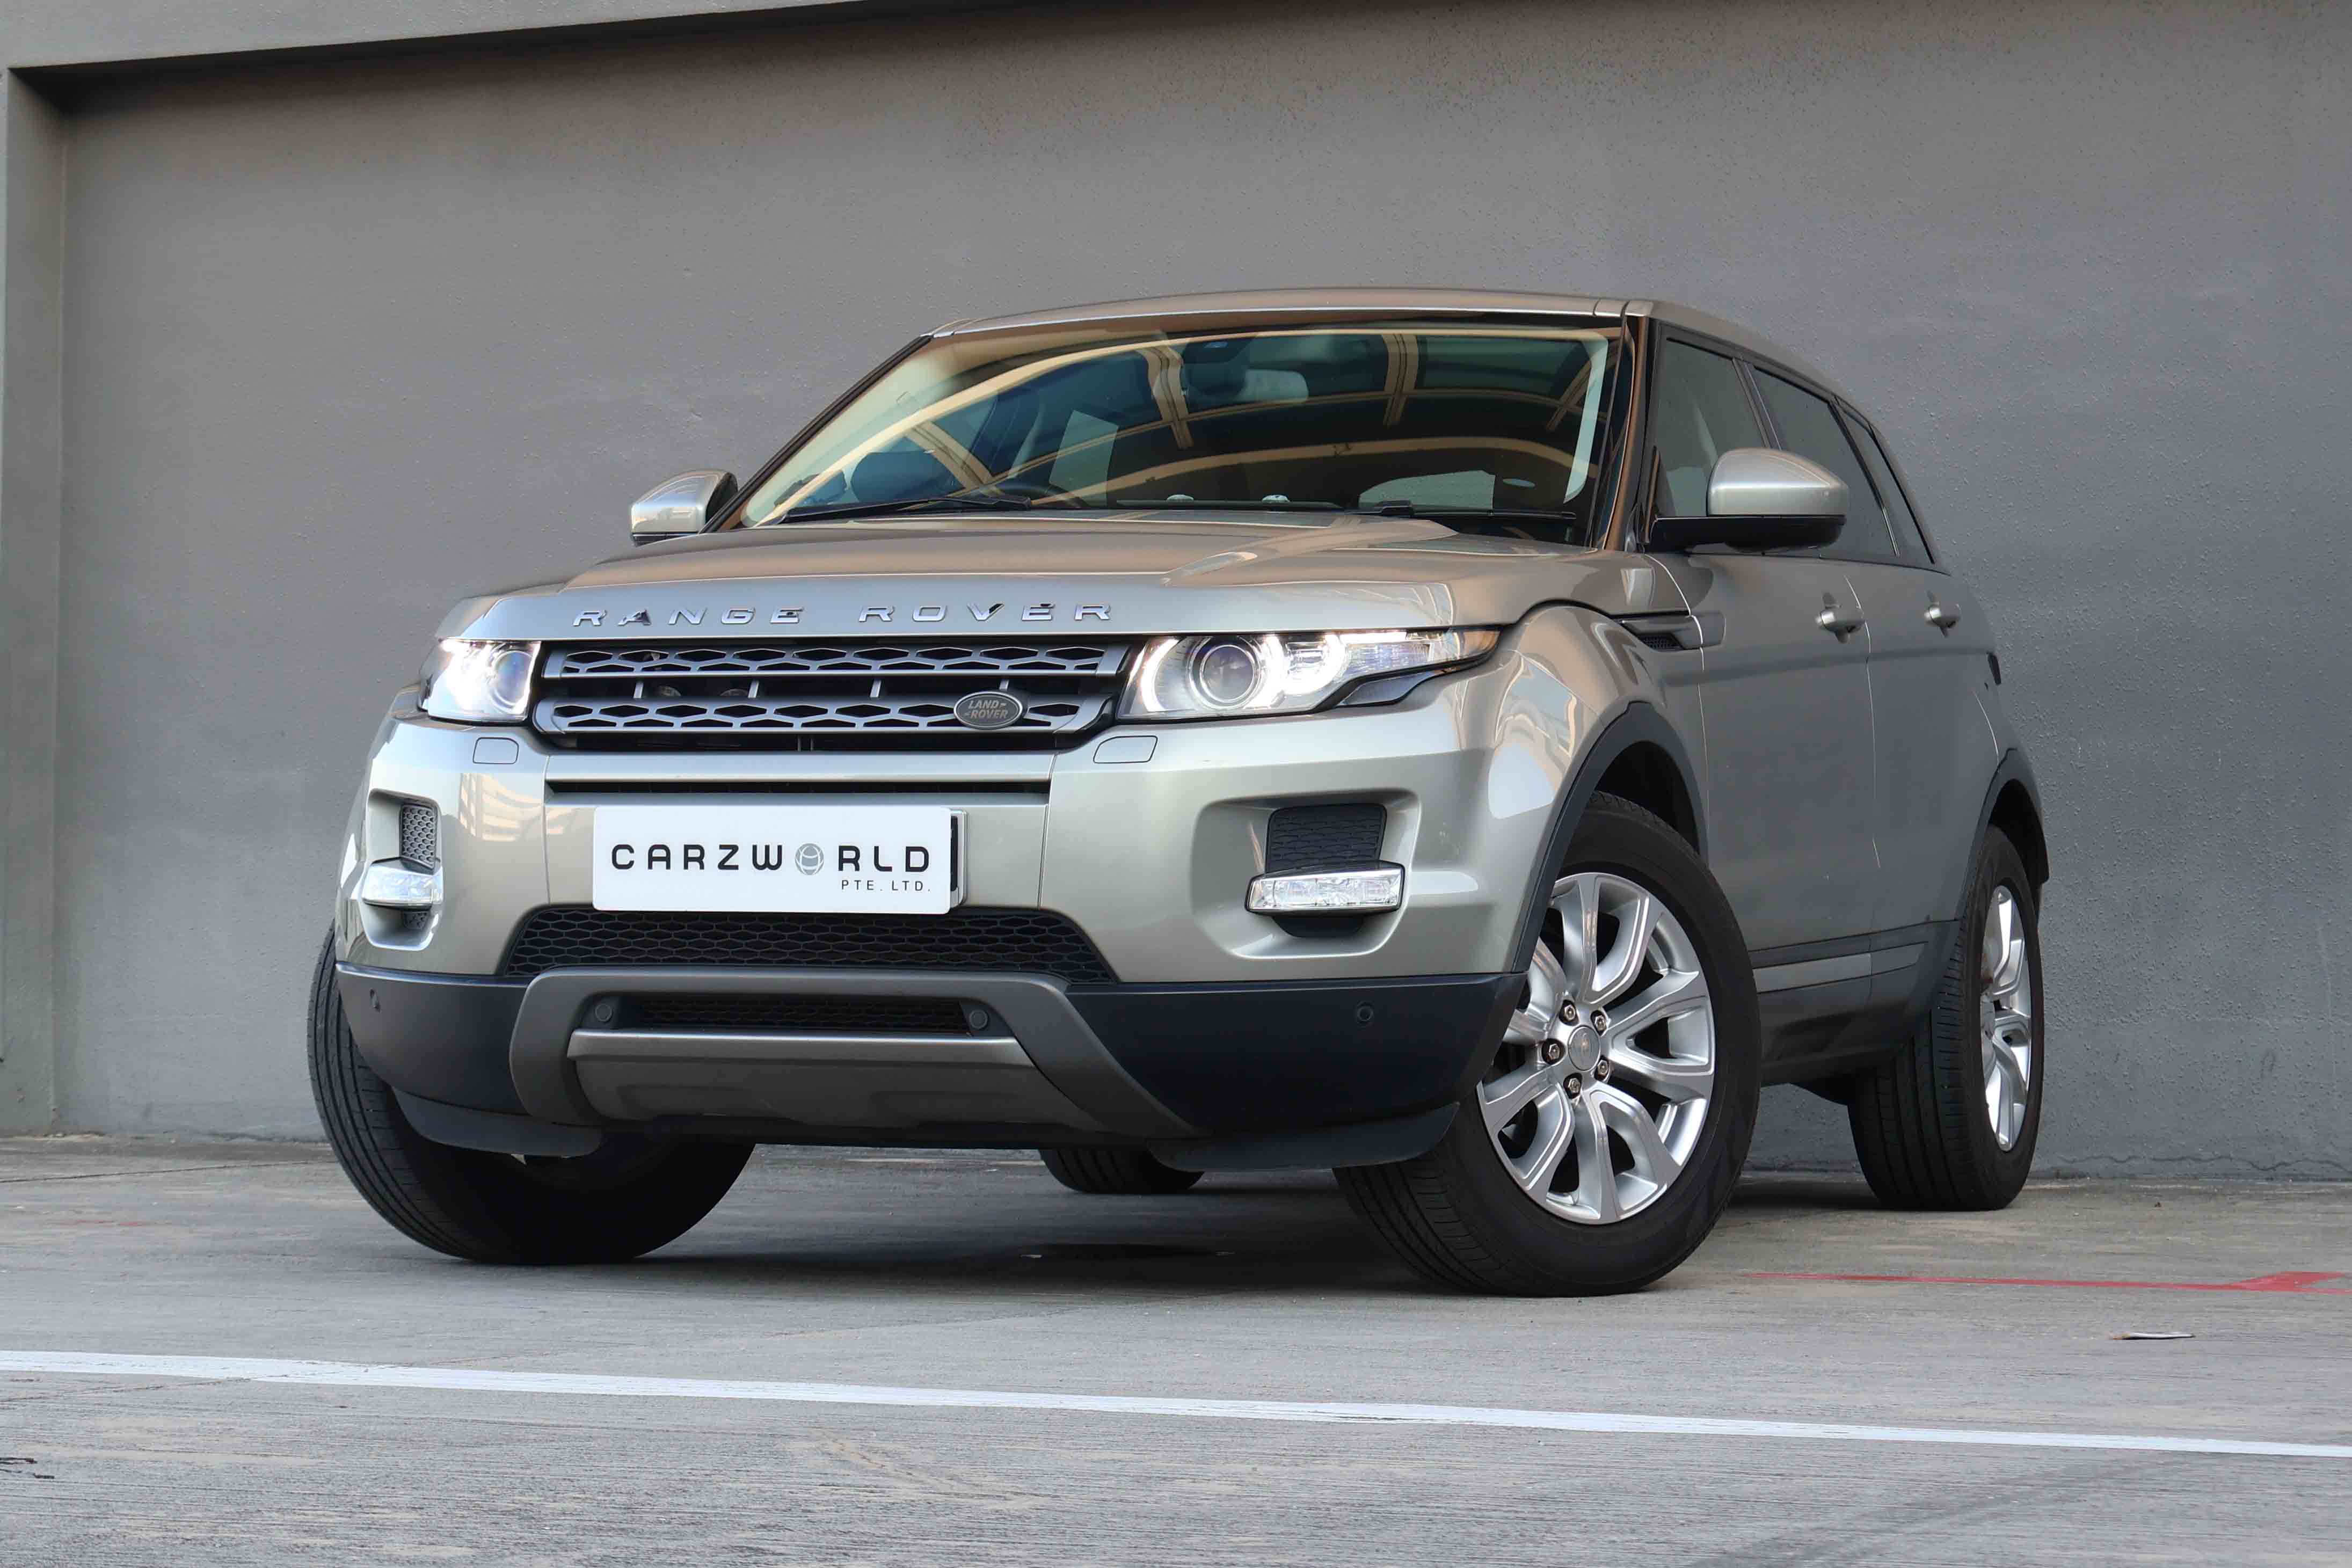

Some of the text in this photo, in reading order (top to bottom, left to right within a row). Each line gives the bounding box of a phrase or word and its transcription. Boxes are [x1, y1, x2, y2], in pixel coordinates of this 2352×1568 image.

[572, 602, 1113, 627] RANGE ROVER
[969, 699, 999, 709] LAND
[970, 709, 1008, 719] ROVER
